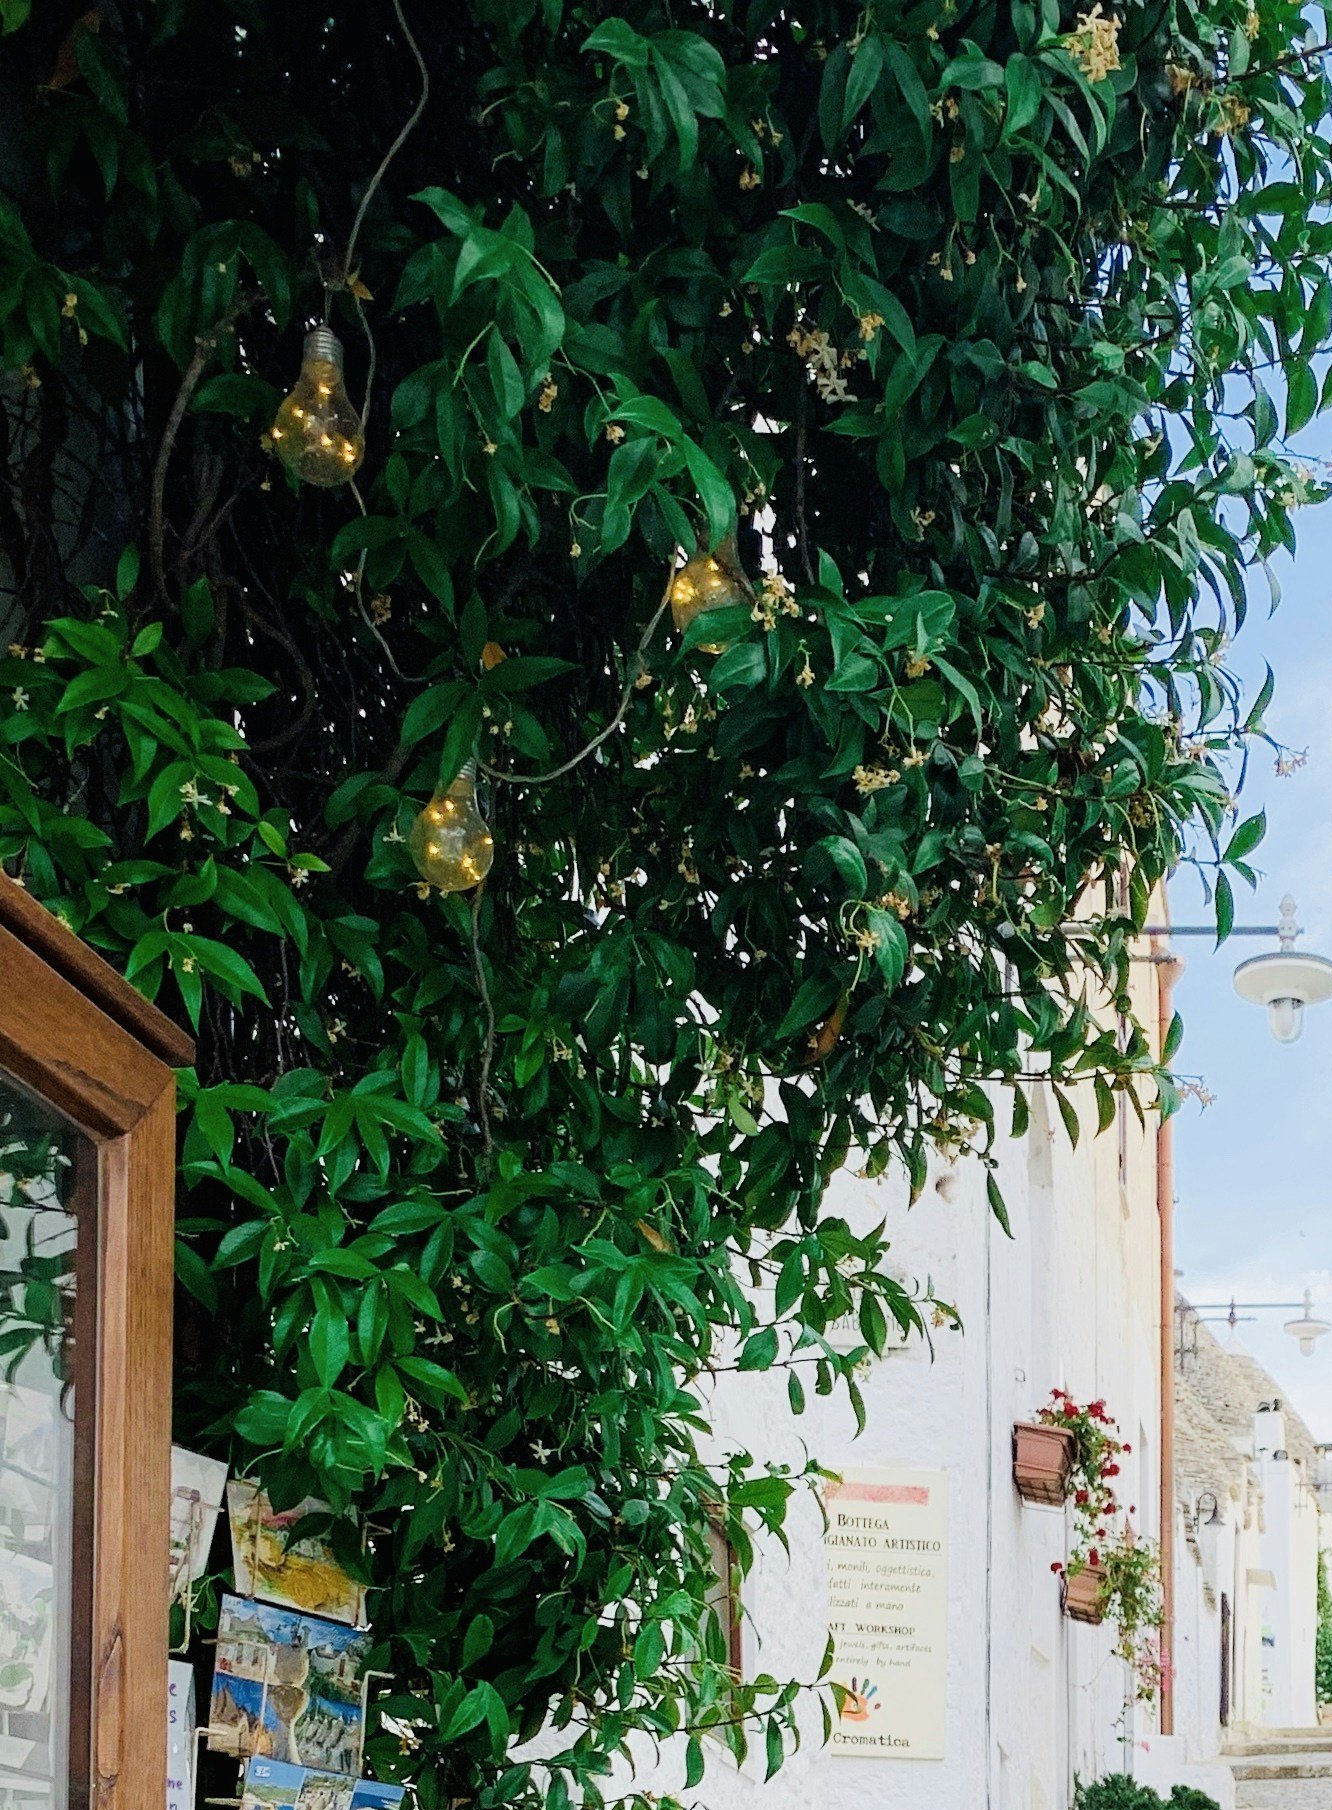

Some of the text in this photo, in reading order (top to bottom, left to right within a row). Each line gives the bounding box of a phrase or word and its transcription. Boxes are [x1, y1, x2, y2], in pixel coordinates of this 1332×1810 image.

[883, 1537, 941, 1552] ARTISTICO
[860, 1580, 921, 1594] interamente
[875, 1601, 904, 1611] mano
[855, 1623, 916, 1636] WORKSHOP
[833, 1732, 910, 1748] Cromatica
